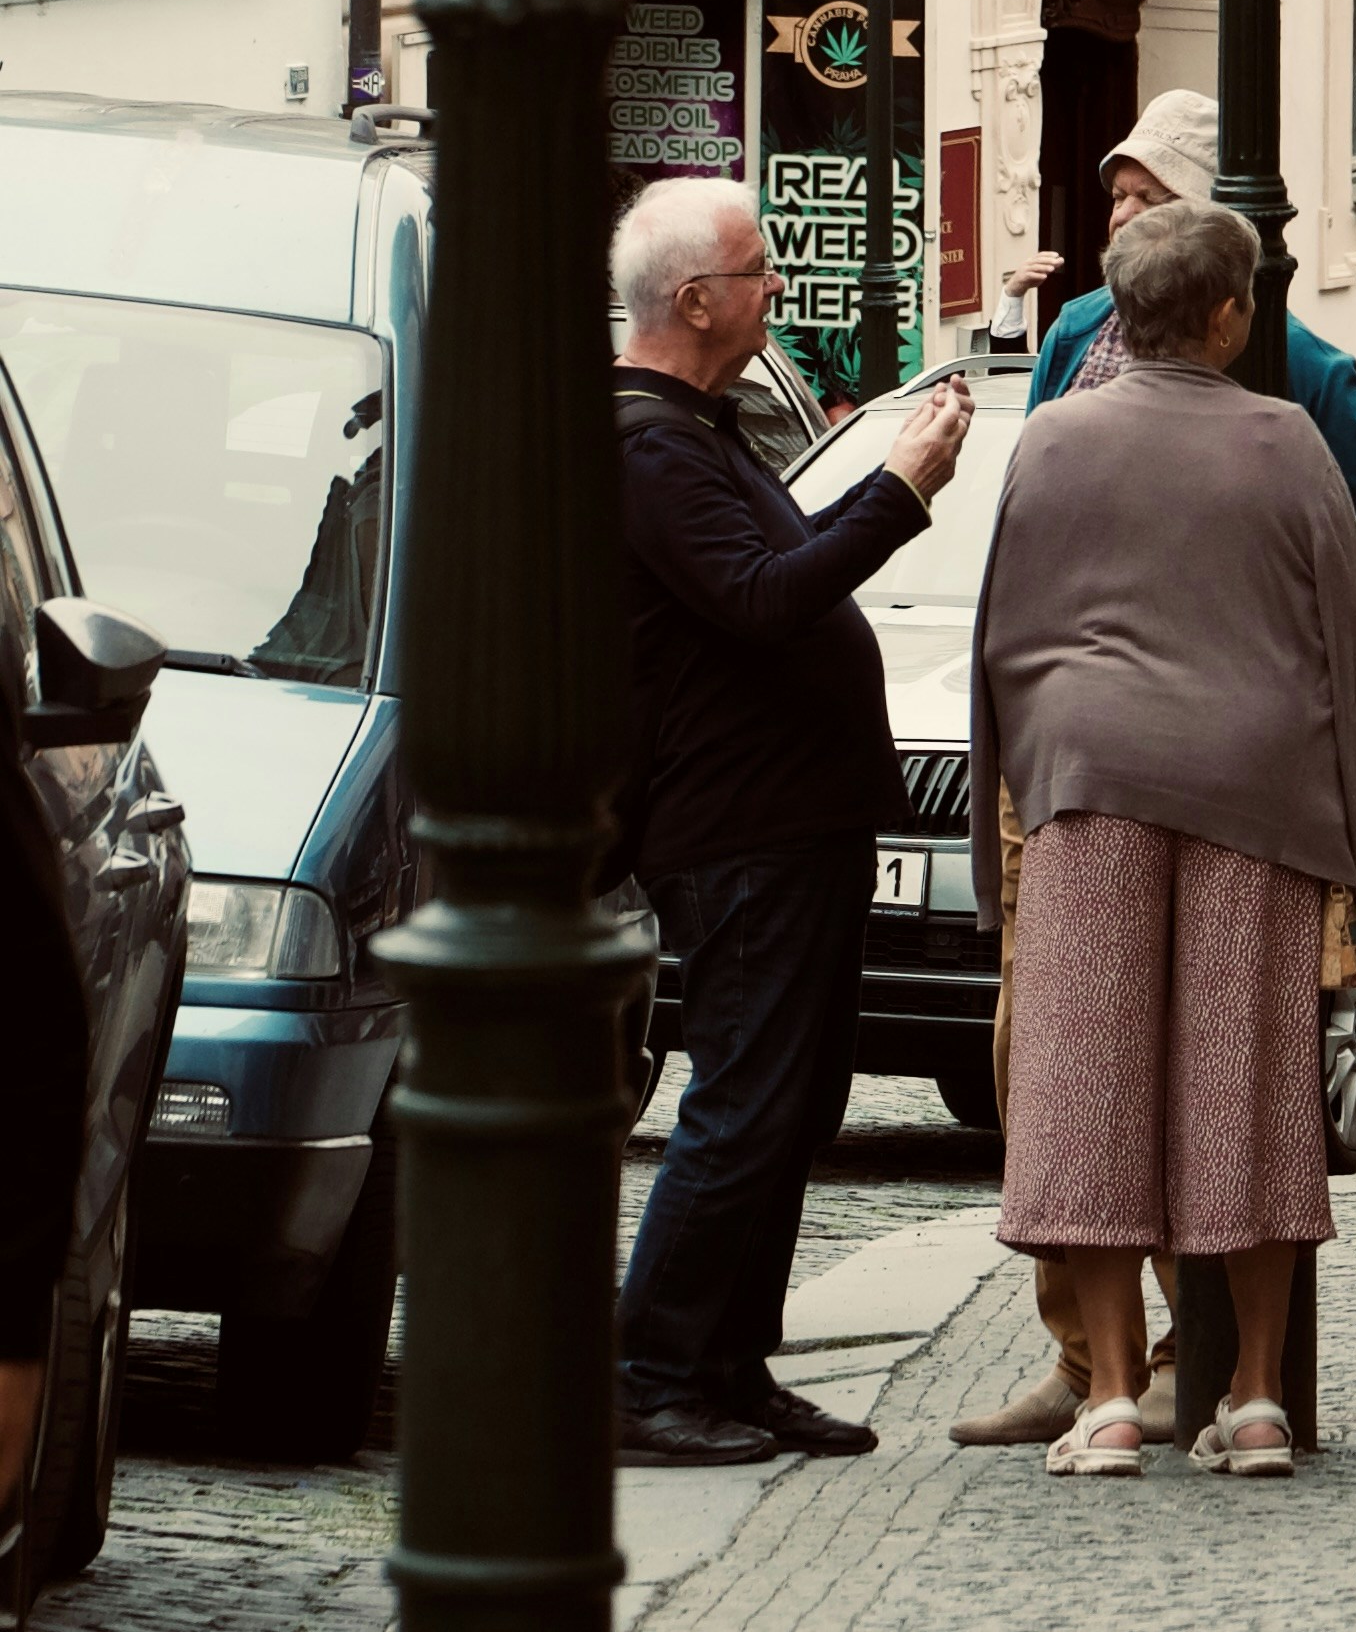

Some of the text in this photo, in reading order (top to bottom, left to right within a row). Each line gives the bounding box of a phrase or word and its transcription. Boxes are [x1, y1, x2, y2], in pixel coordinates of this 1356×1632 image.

[627, 8, 701, 31] WEED
[807, 7, 855, 48] CANNABIS
[614, 39, 719, 65] EDIBLES
[613, 105, 716, 130] CBD OIL
[607, 136, 741, 163] EAD SHOP
